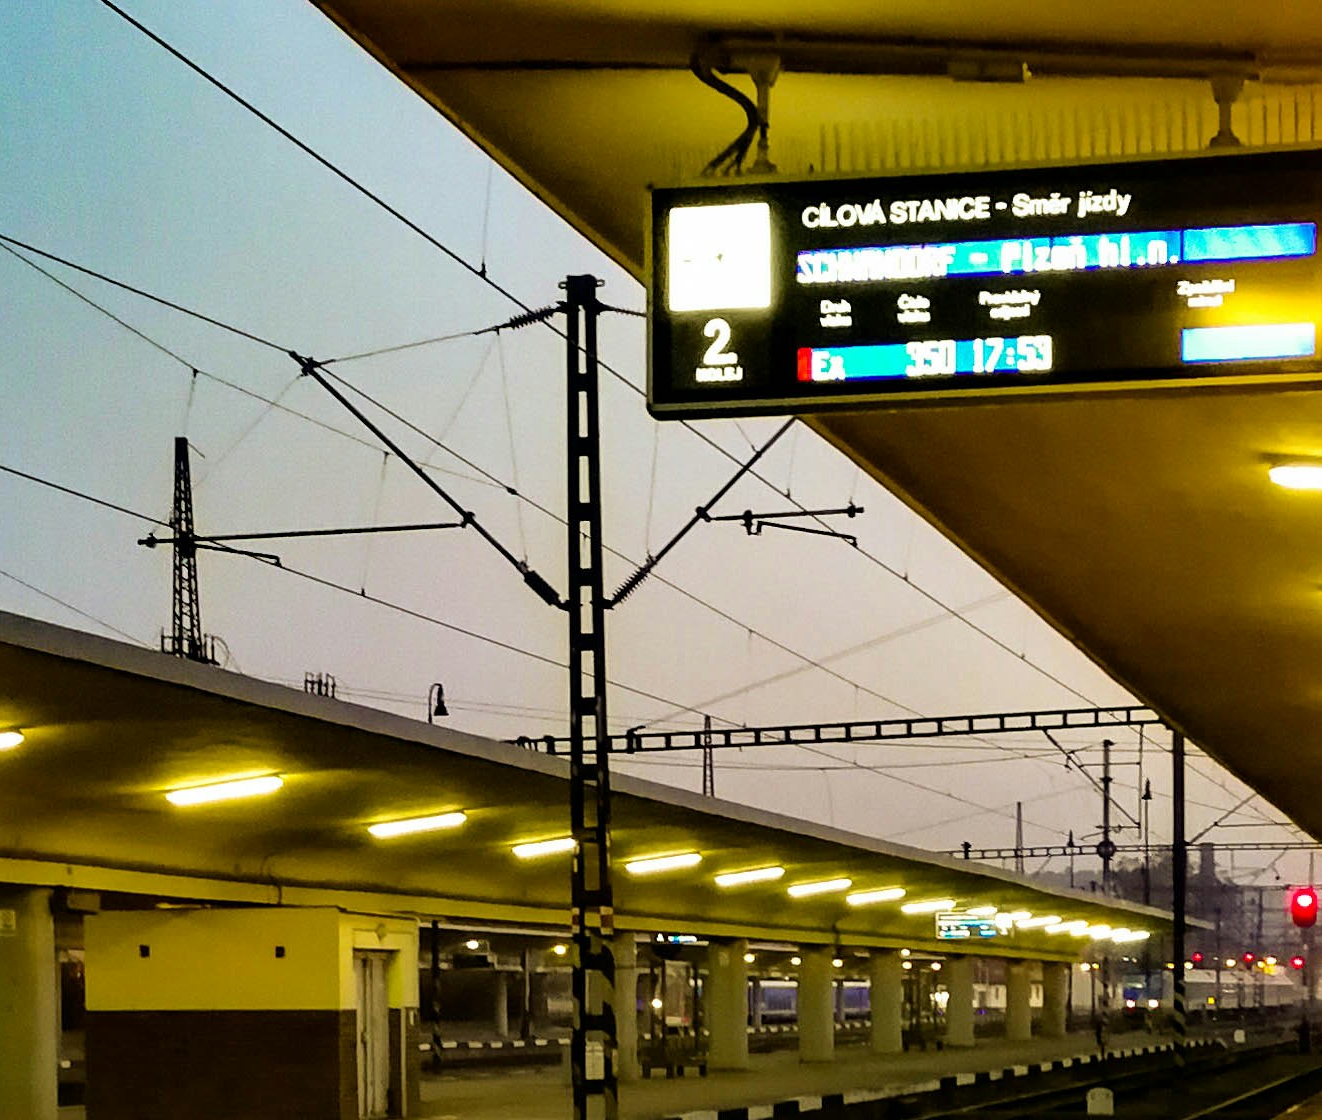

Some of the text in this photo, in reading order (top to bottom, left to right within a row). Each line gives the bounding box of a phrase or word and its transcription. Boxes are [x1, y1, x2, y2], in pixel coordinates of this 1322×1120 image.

[801, 198, 887, 229] CÍLOVÁ
[889, 195, 991, 225] STANICE
[1011, 192, 1072, 218] Směr
[1077, 189, 1132, 218] jízdy
[703, 318, 738, 365] 2
[811, 350, 846, 381] Ex
